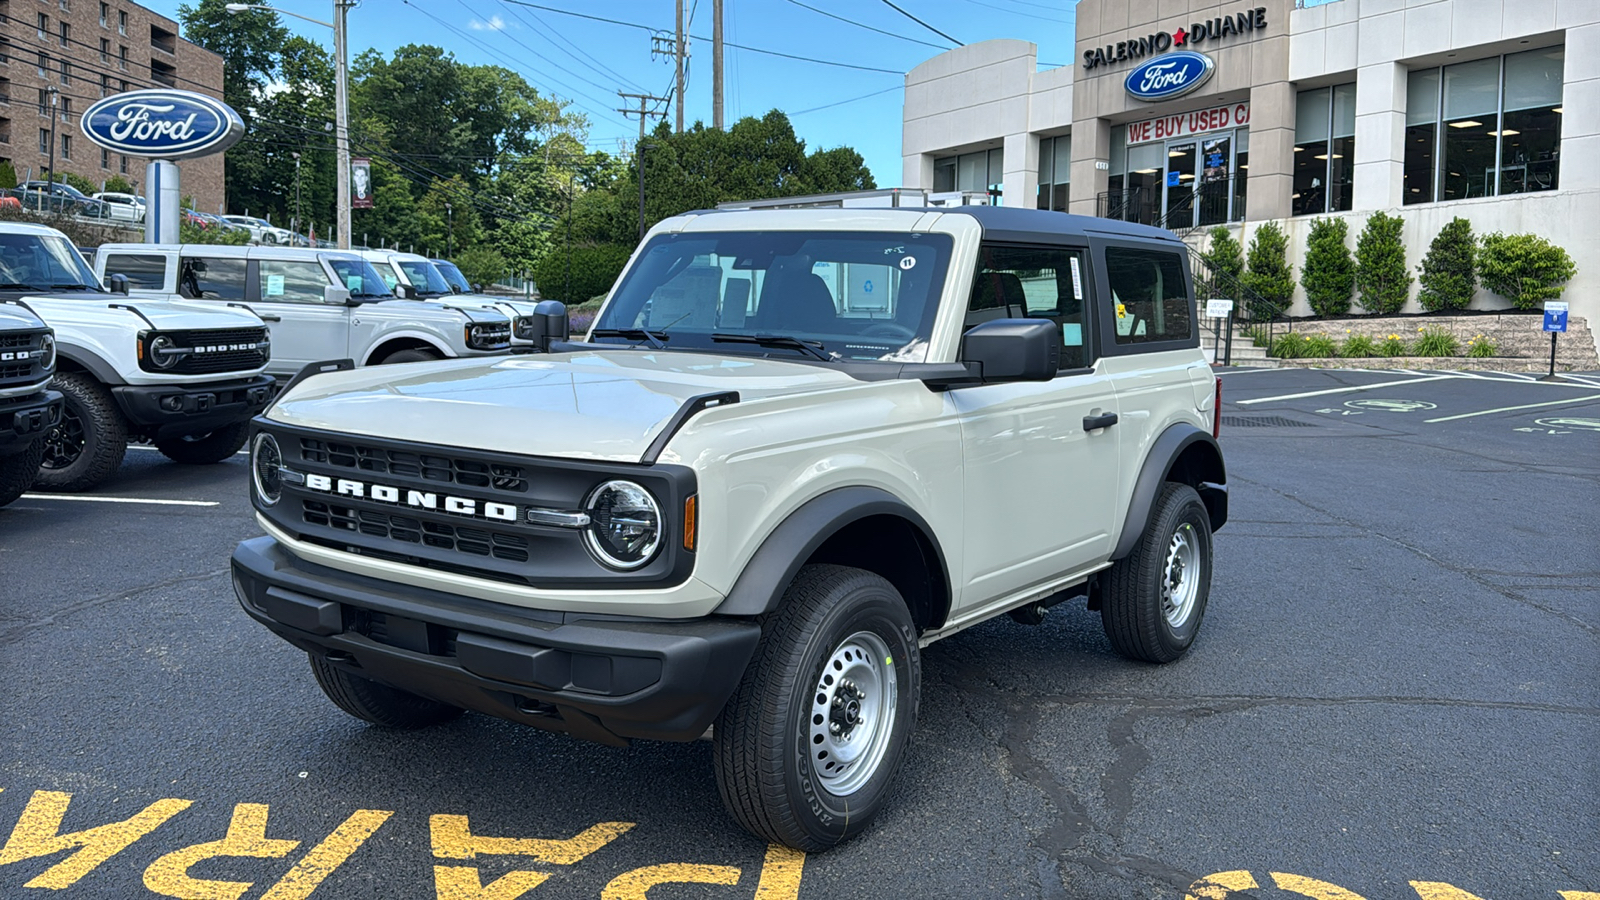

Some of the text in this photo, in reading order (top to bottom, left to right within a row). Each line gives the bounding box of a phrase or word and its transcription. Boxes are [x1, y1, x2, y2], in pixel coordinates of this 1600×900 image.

[1083, 7, 1268, 70] SALERNO DUANE
[1140, 62, 1189, 92] Ford
[109, 104, 198, 141] Ford
[1129, 122, 1151, 143] WE
[1155, 115, 1185, 138] BUY
[1188, 107, 1230, 132] USED
[194, 343, 257, 353] BRONCO
[306, 473, 518, 522] BRONCO
